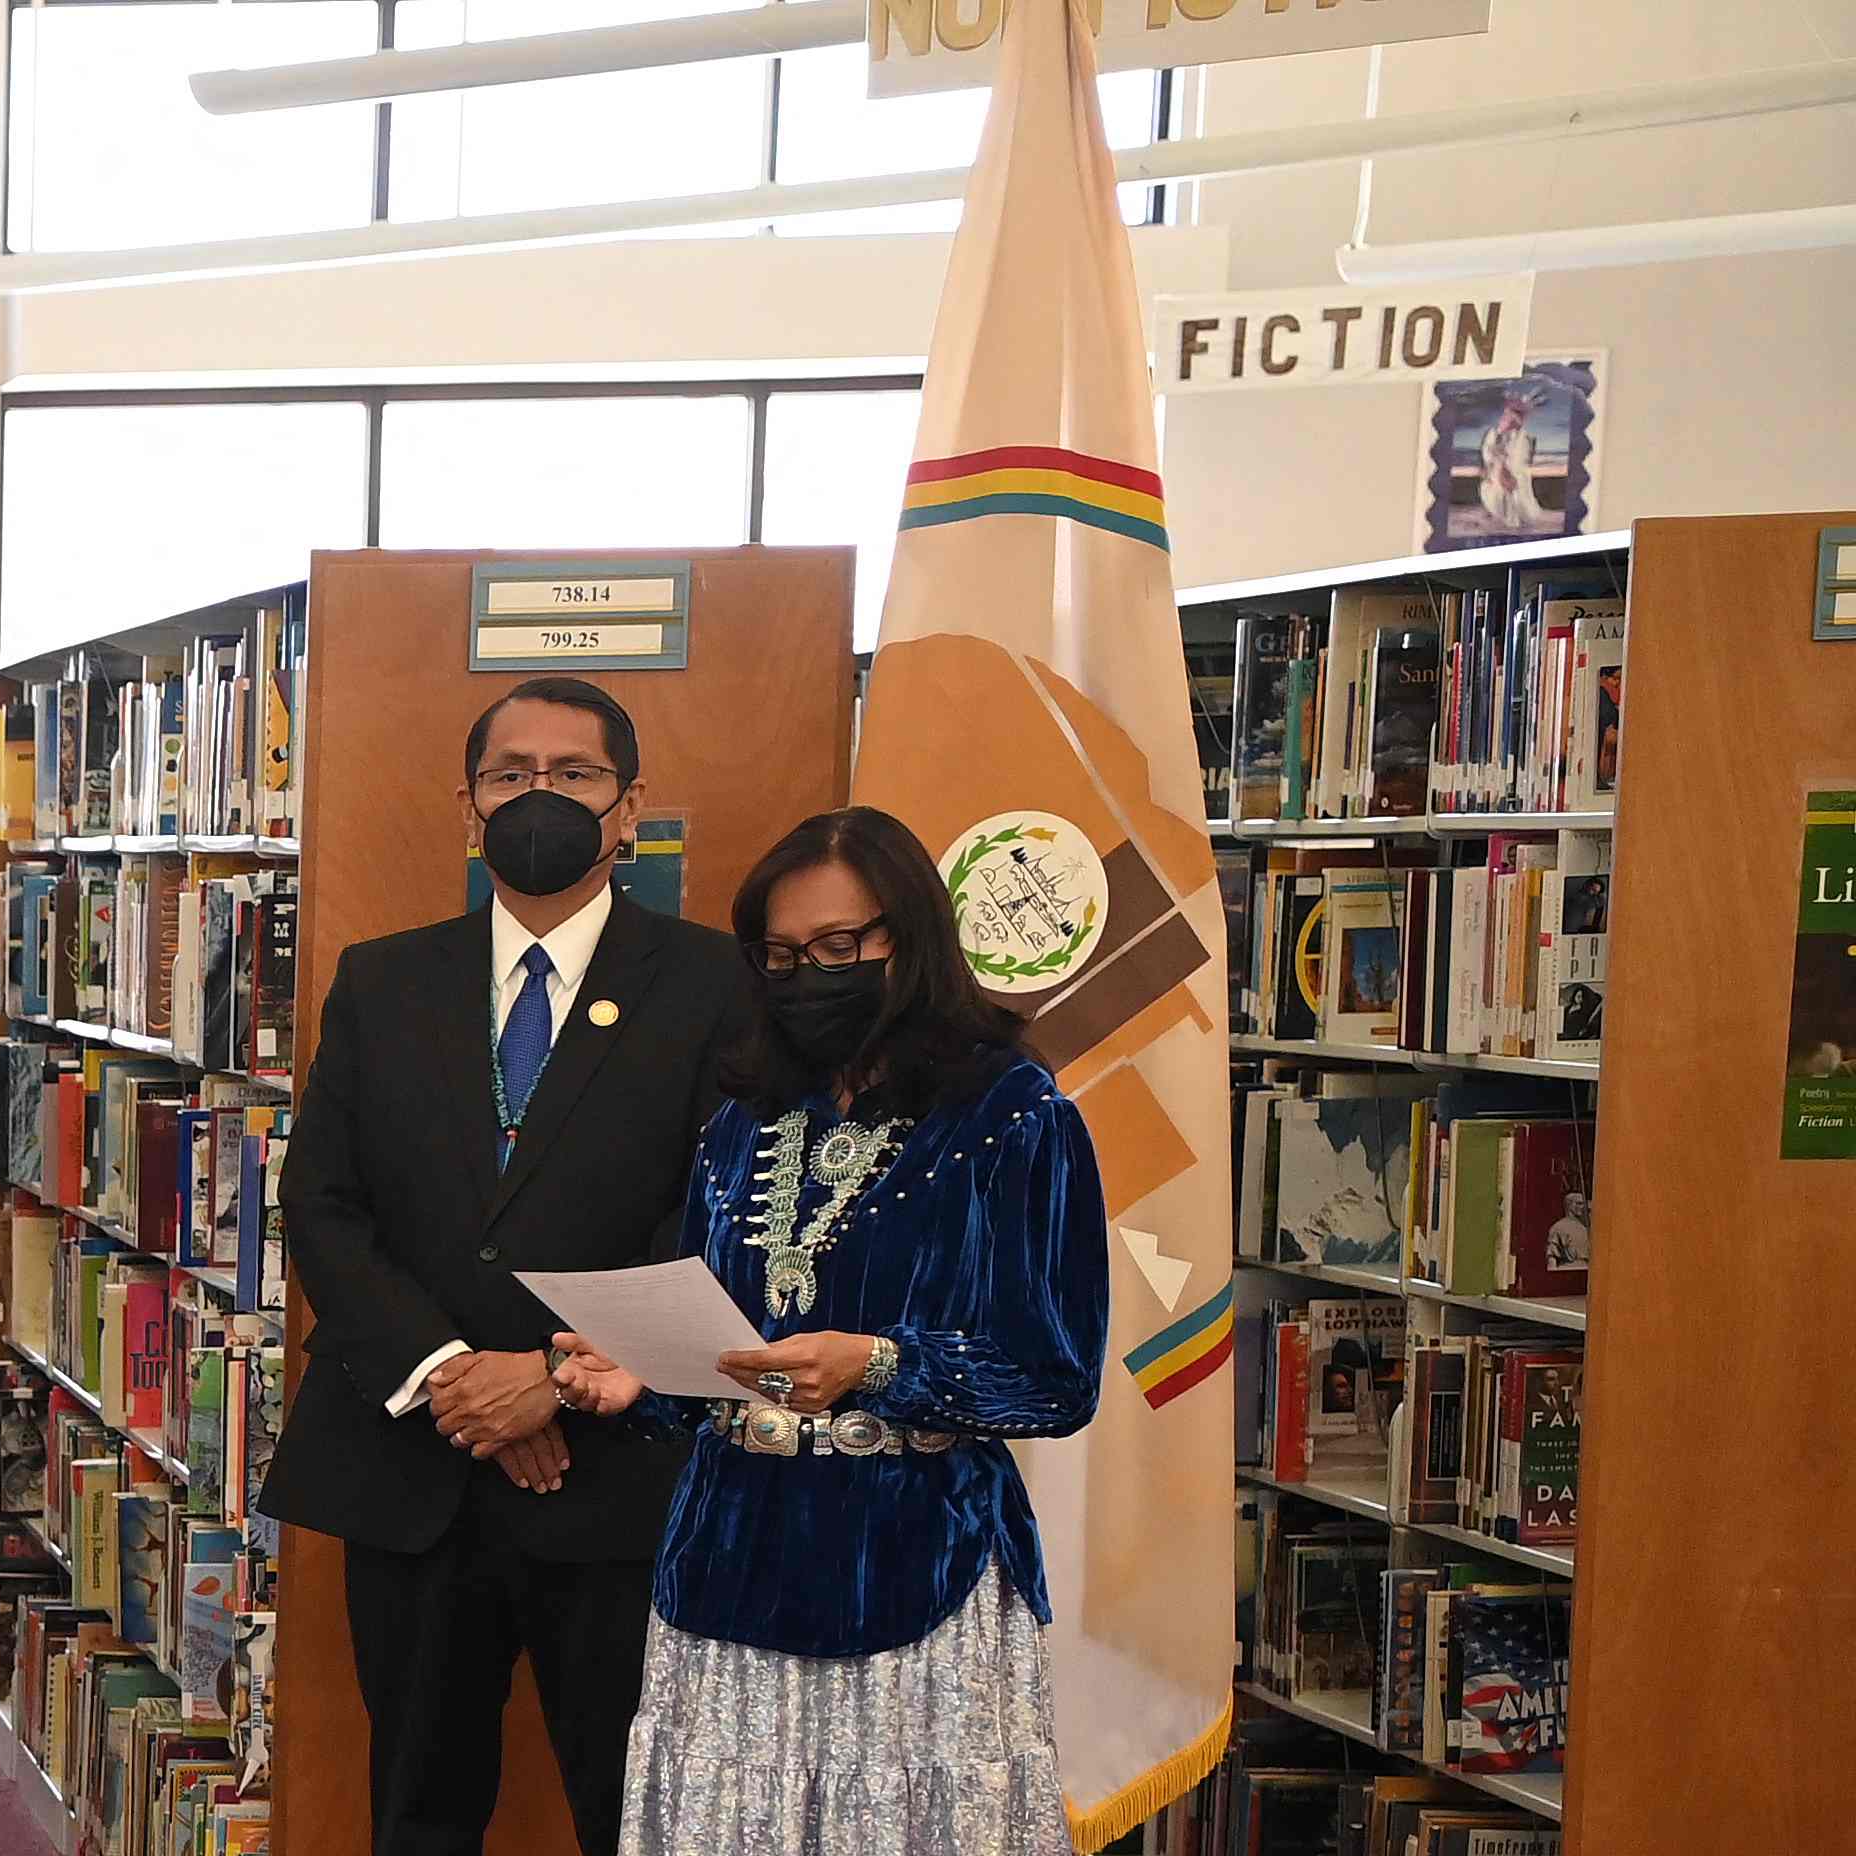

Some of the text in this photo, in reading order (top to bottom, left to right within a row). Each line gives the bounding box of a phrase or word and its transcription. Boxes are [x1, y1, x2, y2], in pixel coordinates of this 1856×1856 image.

[1180, 302, 1501, 380] FICTION
[552, 586, 610, 603] 738.14
[541, 632, 599, 649] 799.25
[1798, 1115, 1843, 1127] Fiction
